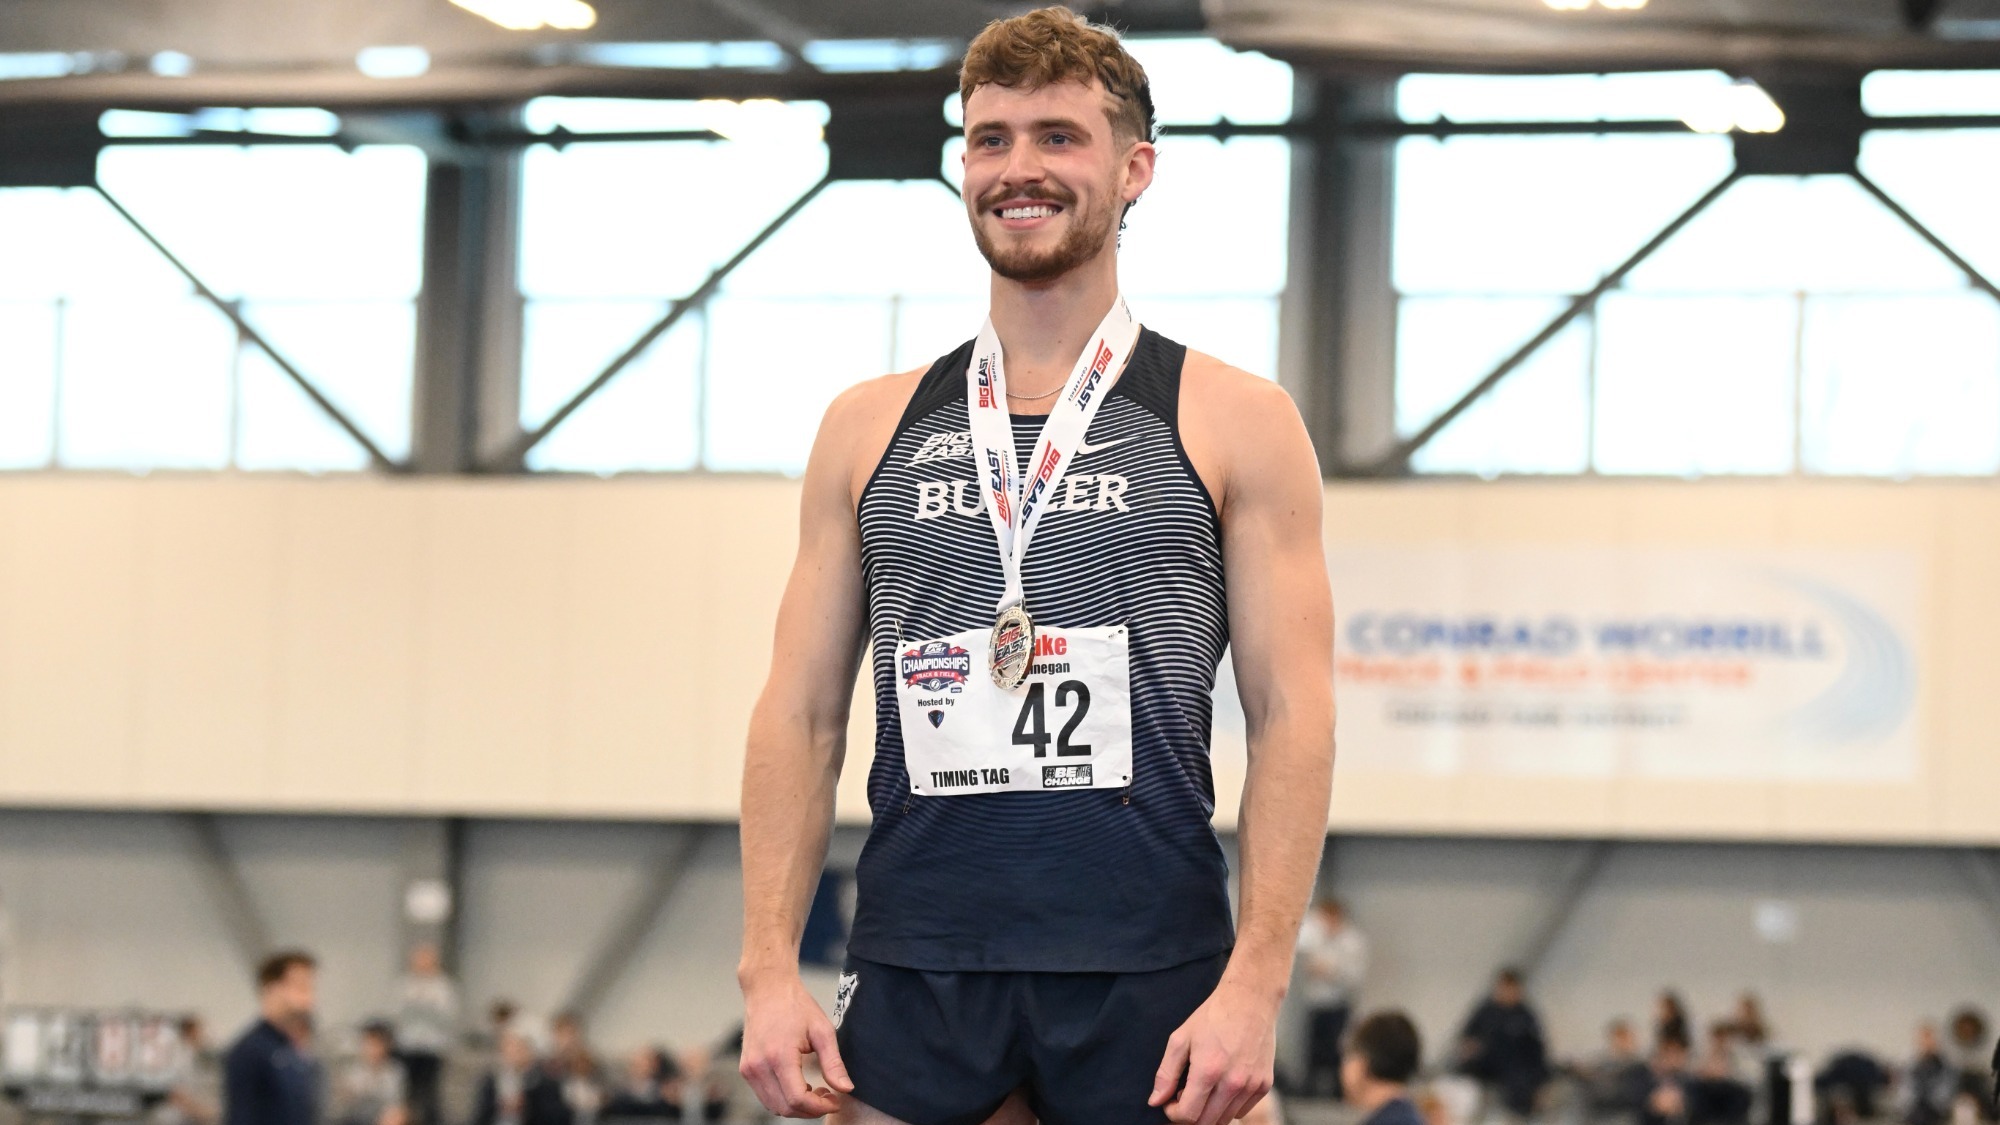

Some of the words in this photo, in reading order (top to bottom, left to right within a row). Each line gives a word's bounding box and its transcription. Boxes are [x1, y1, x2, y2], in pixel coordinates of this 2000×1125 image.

[978, 358, 989, 387] EAST
[1096, 347, 1113, 375] BIG
[979, 387, 989, 408] BIG
[1078, 369, 1102, 412] EAST
[922, 431, 973, 448] BIG
[986, 448, 1002, 493] EAST
[1041, 448, 1061, 483] BIG
[914, 474, 1130, 520] BUER
[993, 490, 1007, 522] BIG
[997, 625, 1022, 649] BIG
[1347, 613, 1580, 656] CONRAD
[994, 636, 1028, 663] EAST
[903, 656, 969, 674] CHAMPIONSHIPS
[915, 671, 932, 679] TRACK
[917, 698, 943, 707] Hosted
[945, 697, 955, 706] by
[1012, 680, 1091, 758] 42
[931, 769, 978, 788] TIMING
[981, 768, 1009, 785] TAG
[1044, 776, 1091, 786] CHANGE
